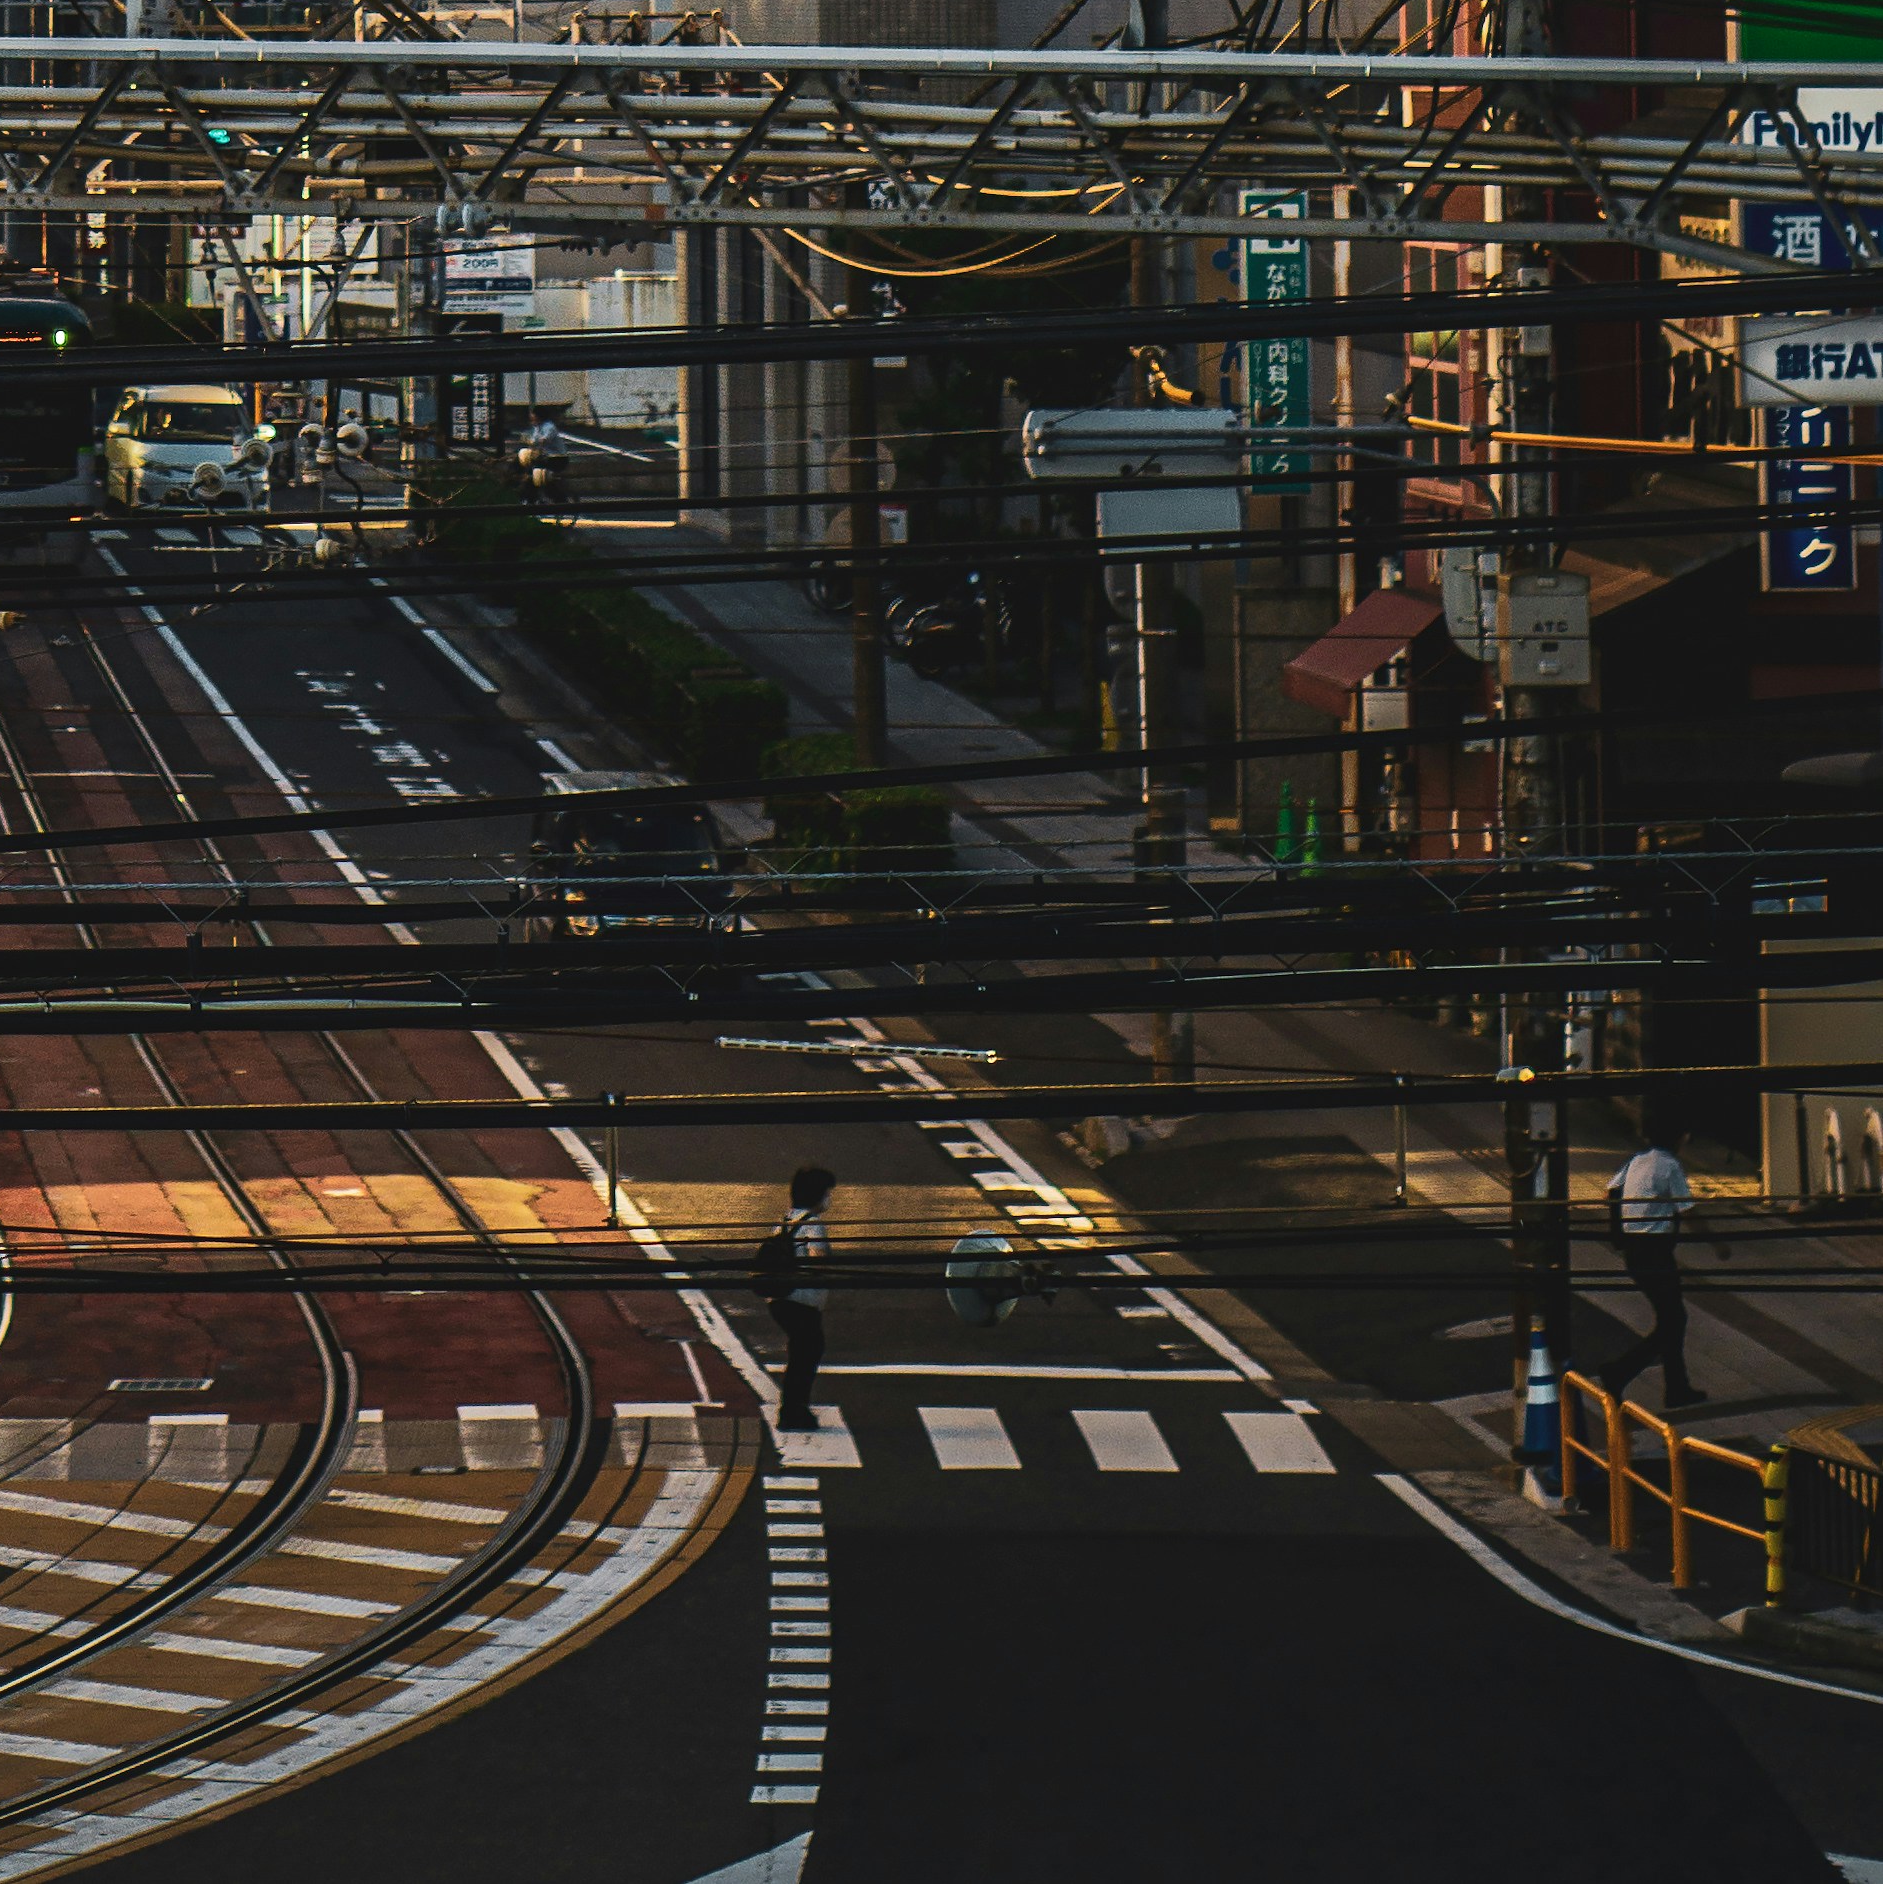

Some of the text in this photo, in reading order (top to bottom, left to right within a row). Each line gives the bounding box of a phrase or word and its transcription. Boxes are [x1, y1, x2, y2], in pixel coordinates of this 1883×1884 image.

[1753, 111, 1883, 152] Family
[1797, 405, 1838, 575] リニク
